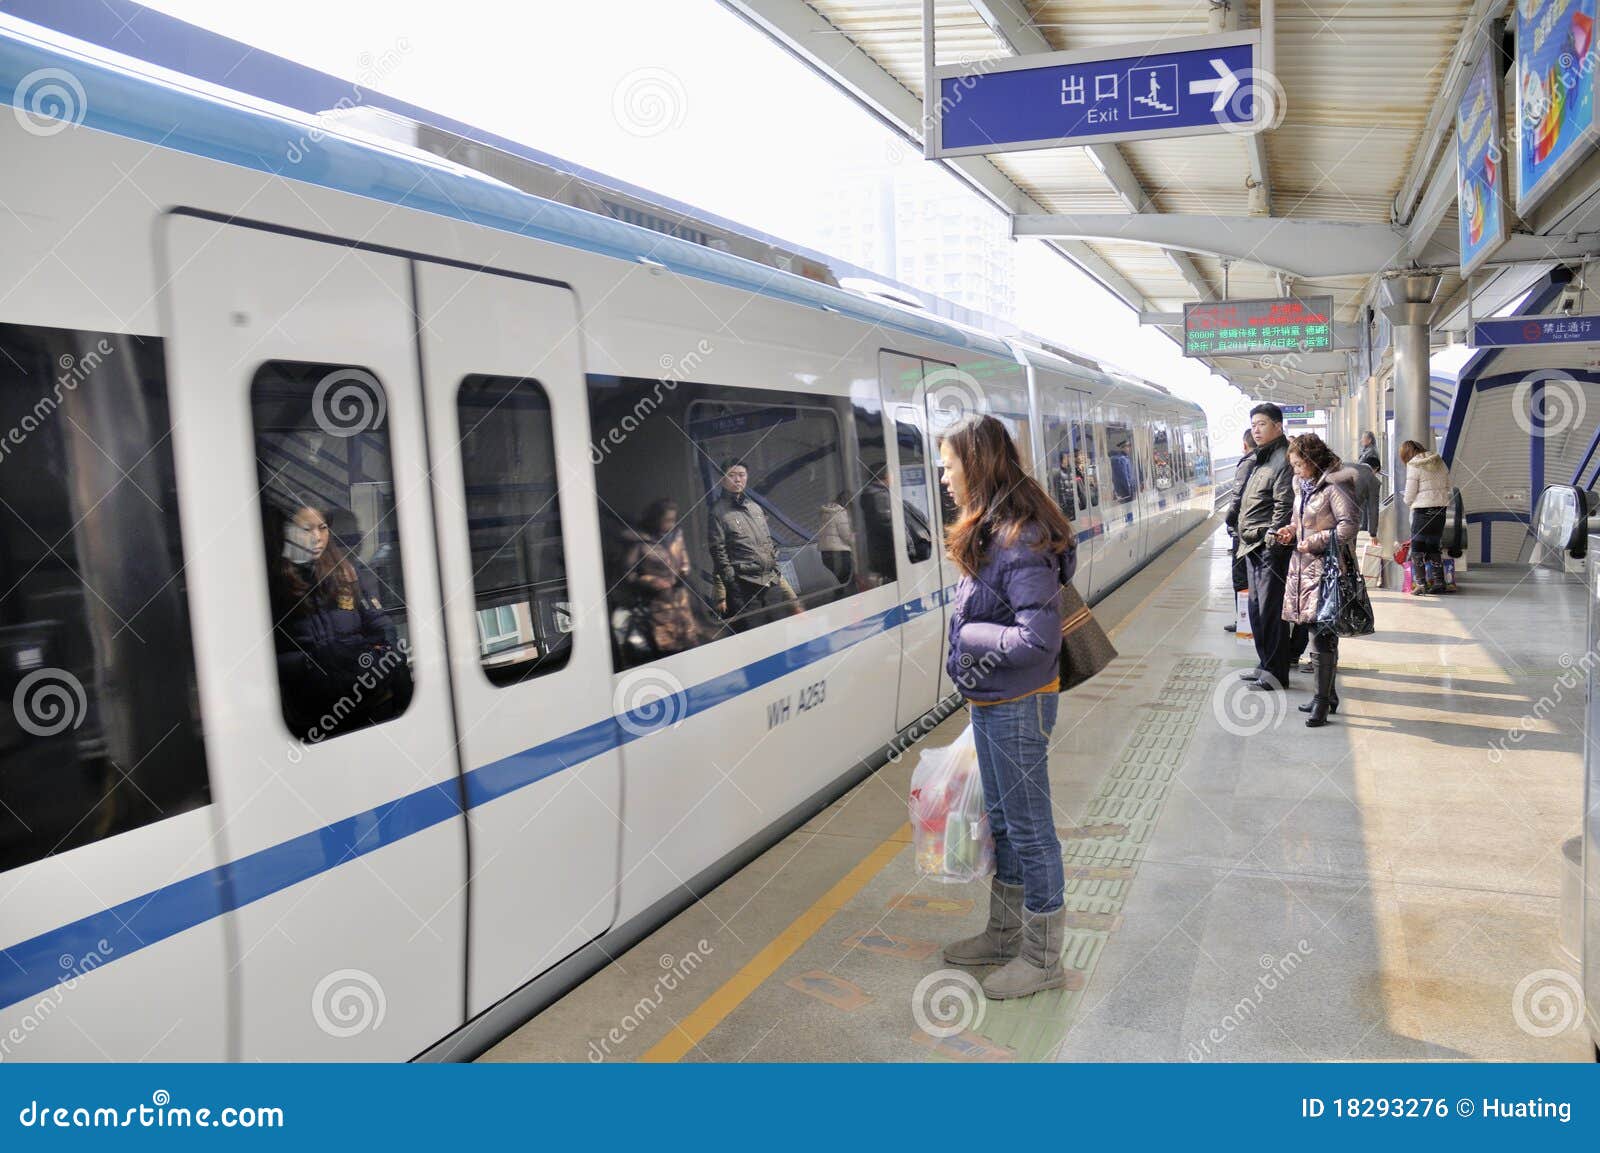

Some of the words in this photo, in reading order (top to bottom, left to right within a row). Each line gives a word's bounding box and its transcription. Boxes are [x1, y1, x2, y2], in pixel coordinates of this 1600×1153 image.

[1061, 74, 1118, 105] 出口
[1087, 107, 1119, 124] Exit
[1543, 320, 1592, 334] 禁止通行
